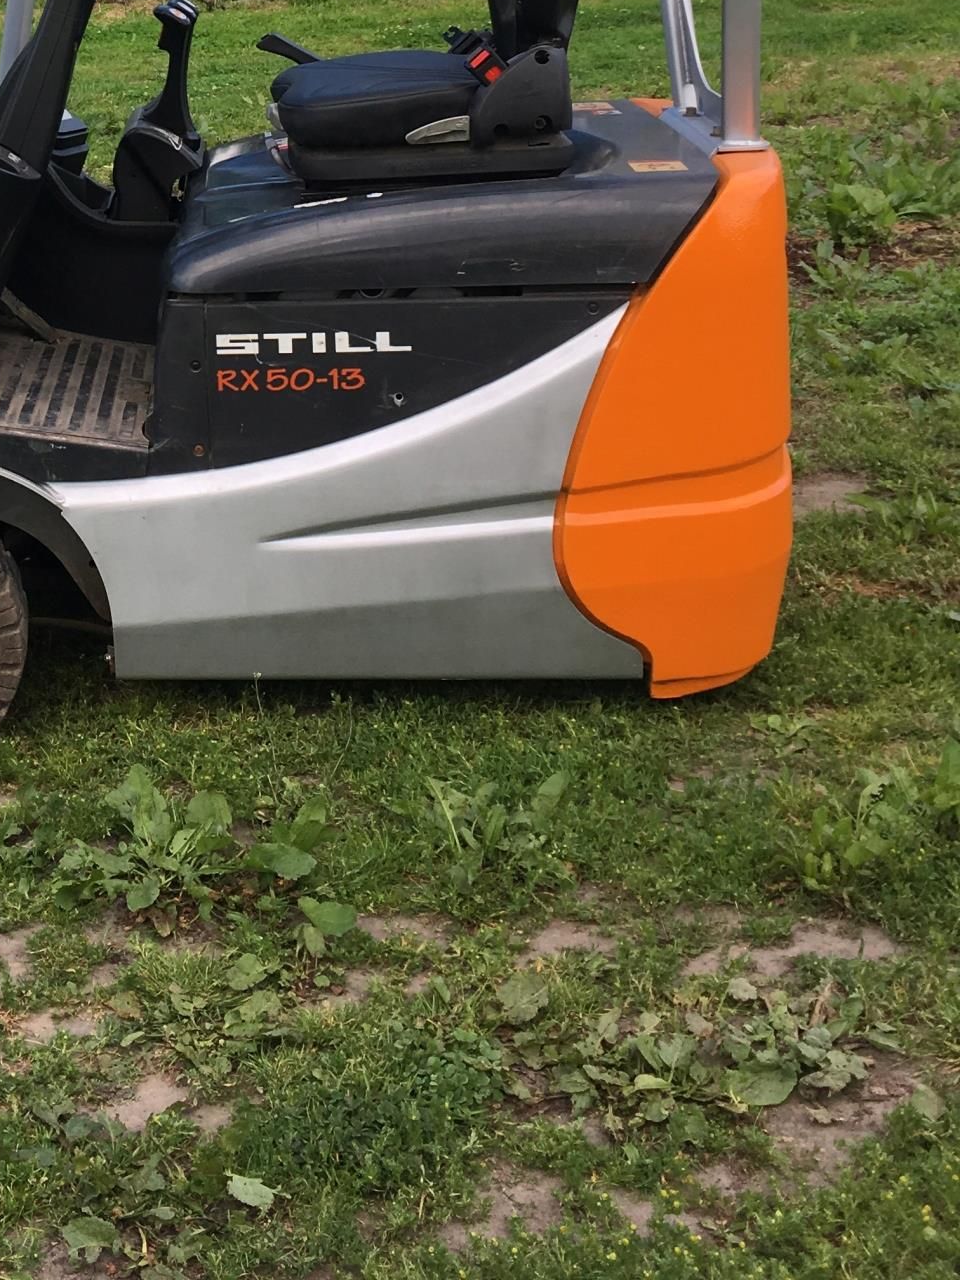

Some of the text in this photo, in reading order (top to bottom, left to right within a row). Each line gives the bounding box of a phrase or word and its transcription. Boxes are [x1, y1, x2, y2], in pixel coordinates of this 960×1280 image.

[216, 331, 412, 355] STILL
[216, 368, 366, 391] RX 50-13
